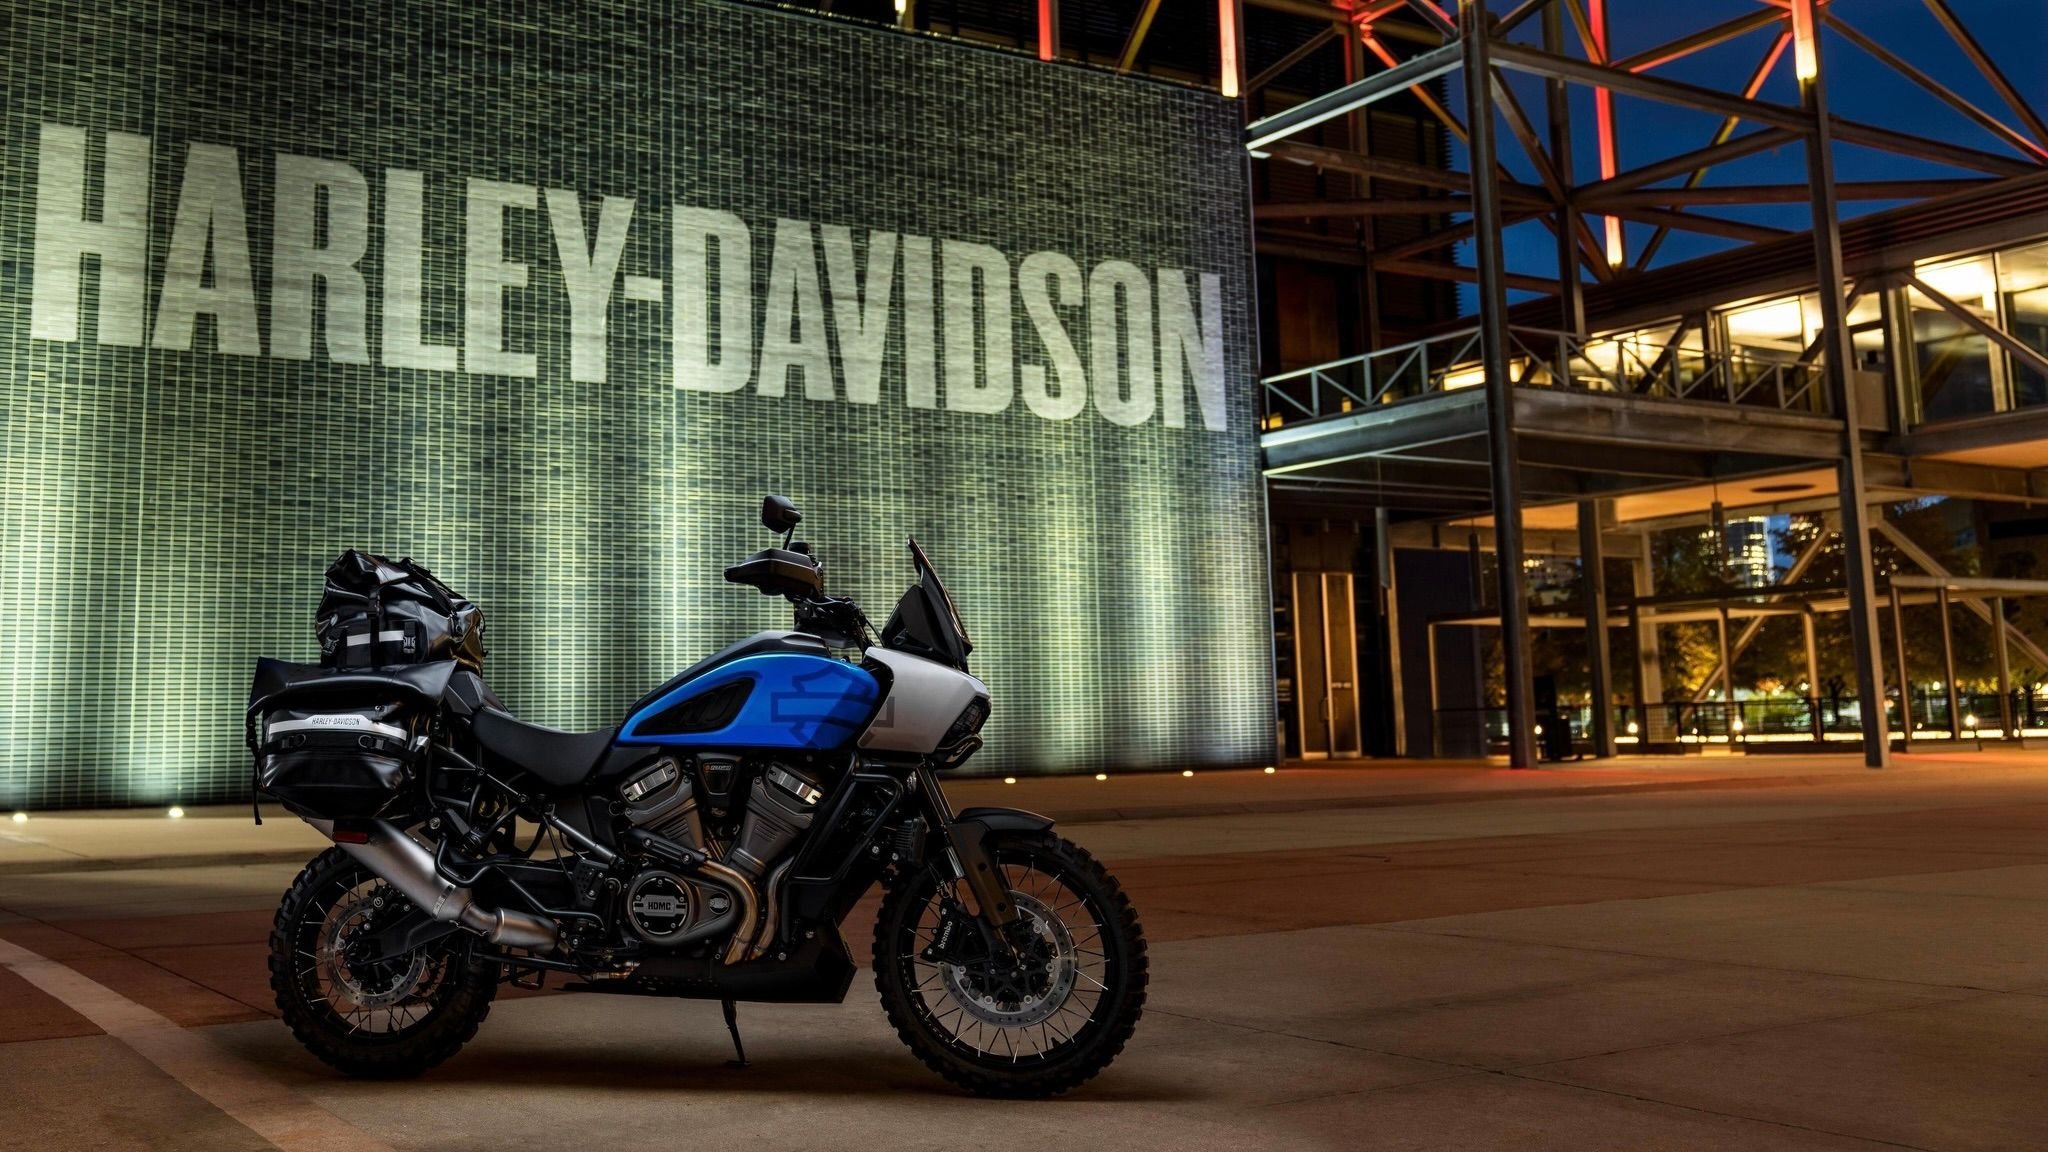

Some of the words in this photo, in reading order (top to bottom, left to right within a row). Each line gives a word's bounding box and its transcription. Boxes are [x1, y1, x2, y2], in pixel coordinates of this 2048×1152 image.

[31, 123, 1227, 431] HARLEY-DAVIDSON
[312, 717, 360, 726] HARLEY-DAVIDSON
[648, 902, 671, 911] HDMC
[938, 921, 952, 949] brembo
